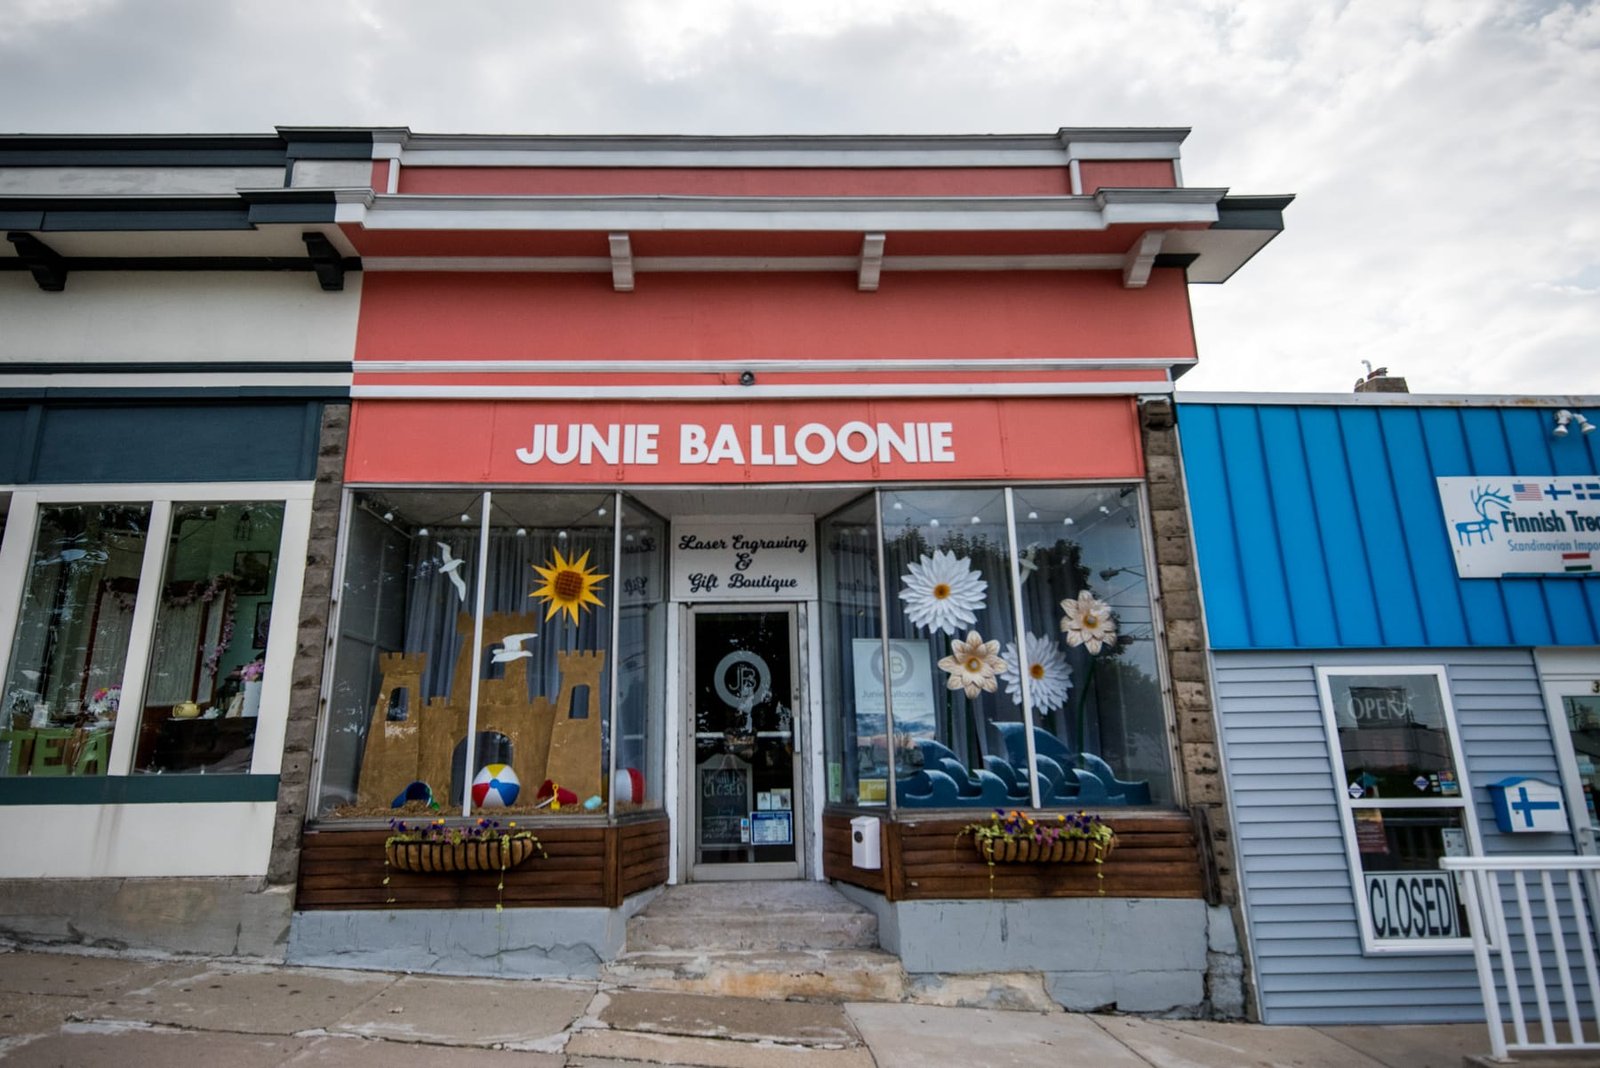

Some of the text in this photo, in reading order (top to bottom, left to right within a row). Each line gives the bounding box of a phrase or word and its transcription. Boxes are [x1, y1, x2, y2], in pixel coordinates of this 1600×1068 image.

[516, 421, 955, 466] JUNIE BALLOONIE
[1500, 510, 1566, 533] Finnish
[678, 534, 808, 554] Laser Engraving
[1507, 539, 1600, 553] Scandinavian Impo
[735, 552, 753, 571] &
[688, 573, 798, 593] Gift Boutique
[1370, 878, 1452, 937] CLOSED
